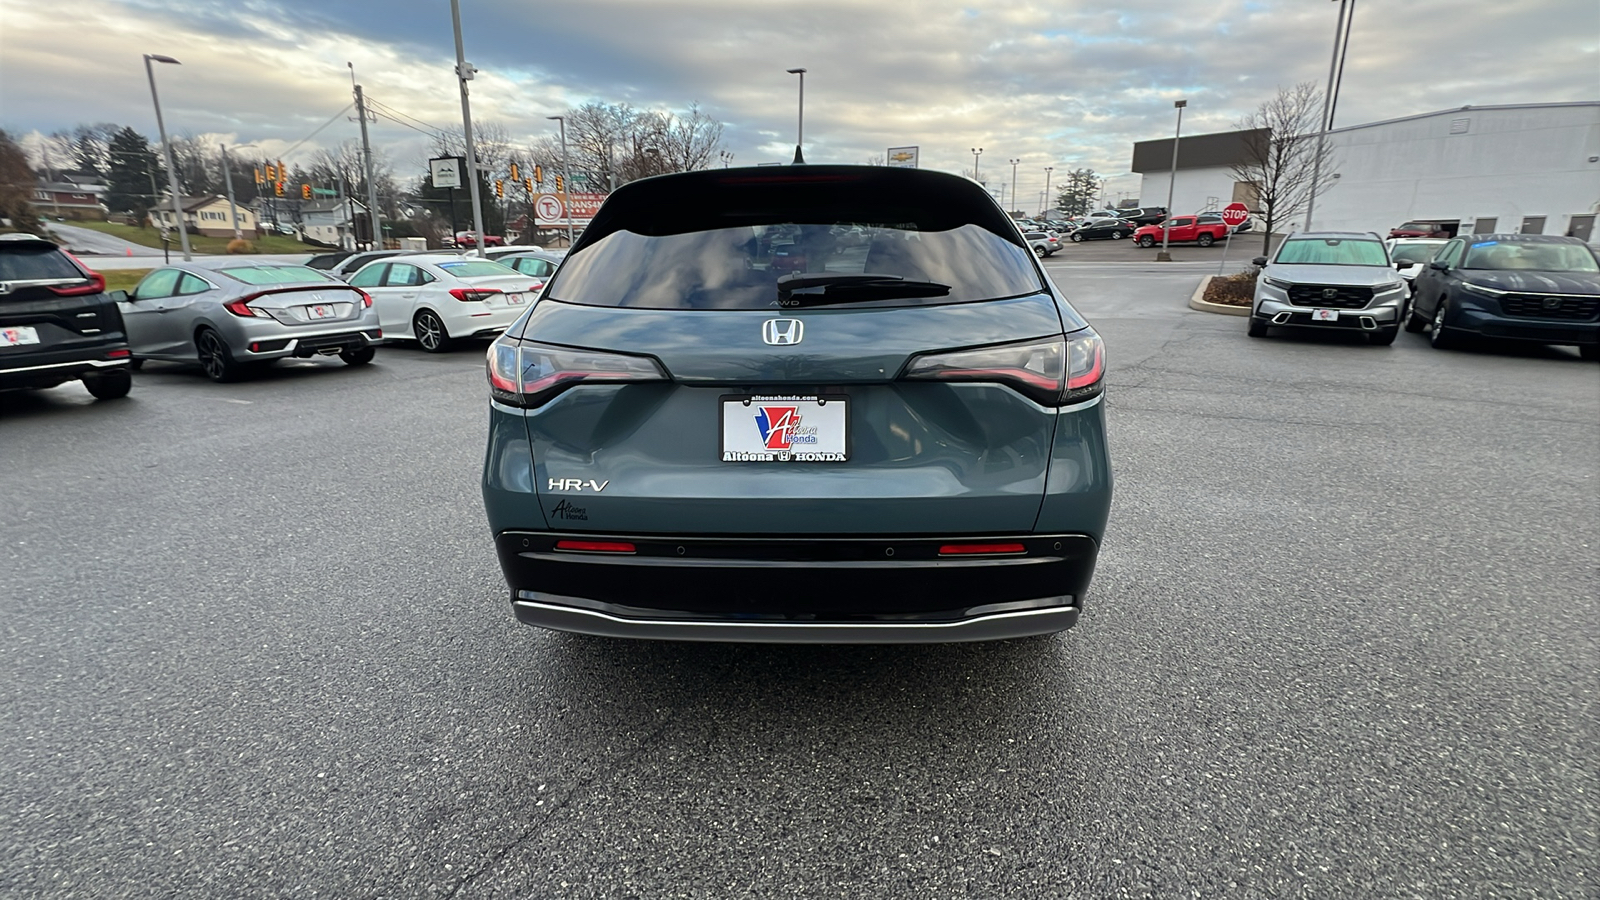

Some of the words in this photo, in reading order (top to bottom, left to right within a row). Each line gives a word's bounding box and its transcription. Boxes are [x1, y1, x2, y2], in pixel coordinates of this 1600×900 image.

[1223, 209, 1247, 219] STOP
[765, 409, 817, 445] Altoona
[786, 434, 816, 444] Honda
[723, 451, 774, 461] Altoona
[795, 453, 846, 461] HONDA
[548, 478, 609, 492] HR-V
[551, 499, 587, 519] Altoona
[566, 512, 588, 521] Honda
